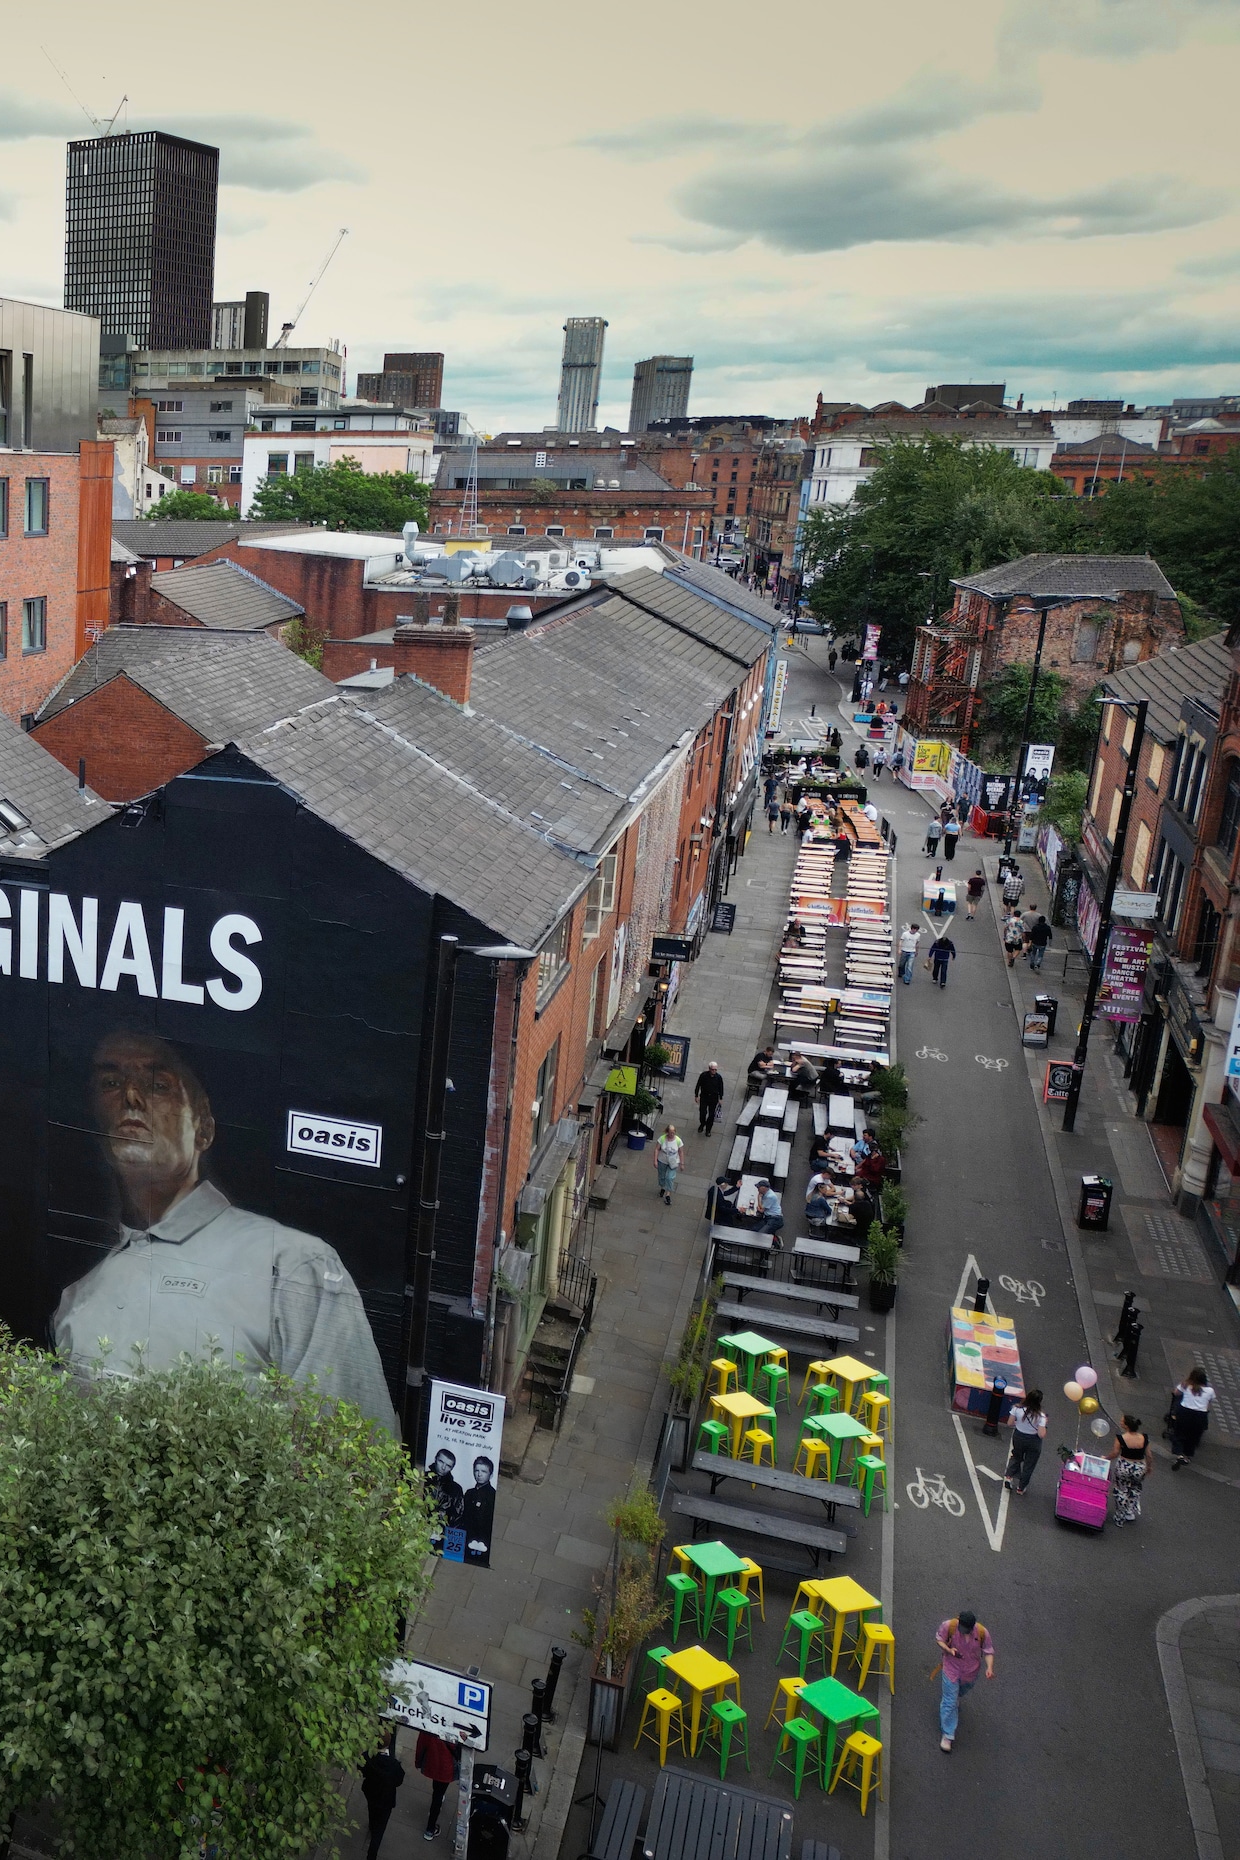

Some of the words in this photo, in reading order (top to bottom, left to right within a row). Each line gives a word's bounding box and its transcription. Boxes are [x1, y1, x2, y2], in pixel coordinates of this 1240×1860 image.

[1112, 944, 1148, 953] FESTIVAL
[1107, 974, 1138, 983] THEATRE
[1112, 994, 1139, 1002] EVENTS
[298, 1127, 371, 1152] oasis
[164, 1280, 199, 1290] oasis
[446, 1399, 489, 1416] oasis
[440, 1413, 466, 1427] live
[452, 1429, 472, 1437] HEATON
[448, 1530, 464, 1538] MCR
[446, 1541, 462, 1553] 25
[463, 1685, 482, 1707] P
[388, 1702, 424, 1719] urch
[430, 1714, 447, 1727] St
